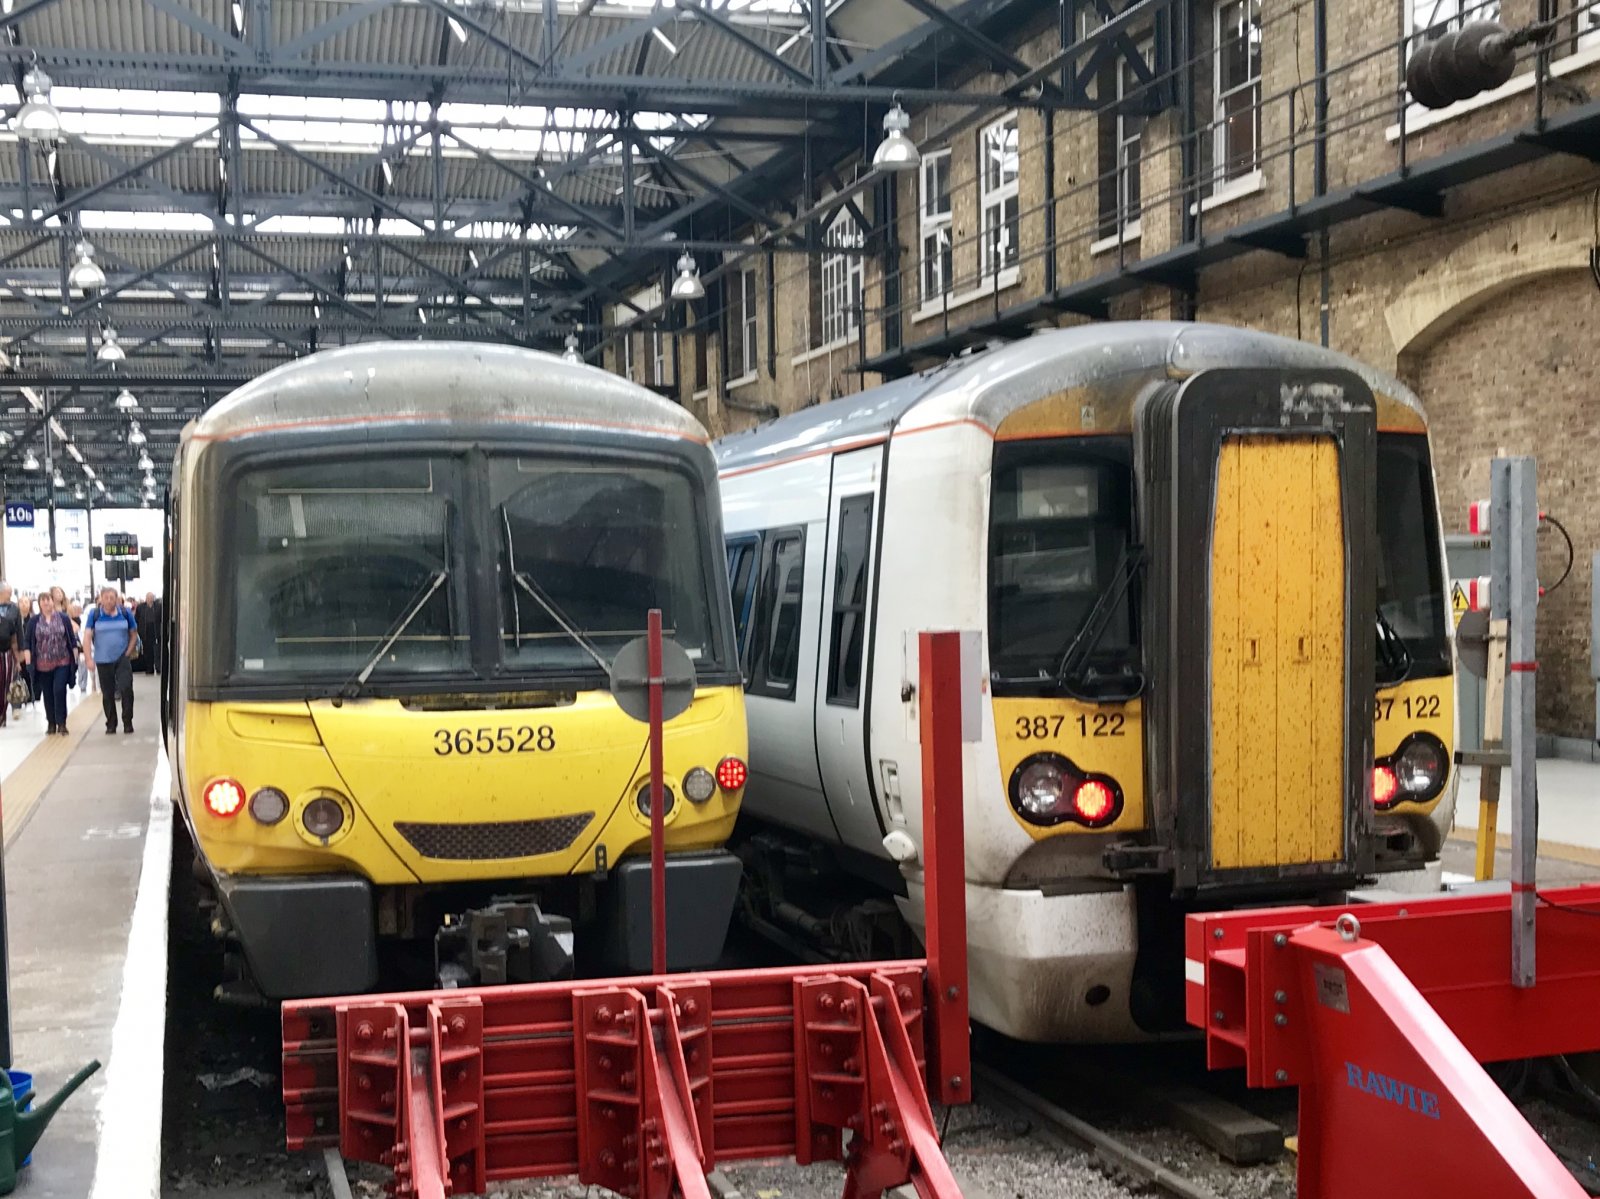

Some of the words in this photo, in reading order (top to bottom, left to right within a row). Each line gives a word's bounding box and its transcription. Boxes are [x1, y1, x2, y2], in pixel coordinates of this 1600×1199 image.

[8, 506, 33, 522] 10b
[1403, 694, 1441, 719] 122
[1016, 715, 1065, 740] 387
[1076, 712, 1126, 738] 122
[433, 725, 556, 756] 365528
[1344, 1060, 1440, 1120] RAWIE
